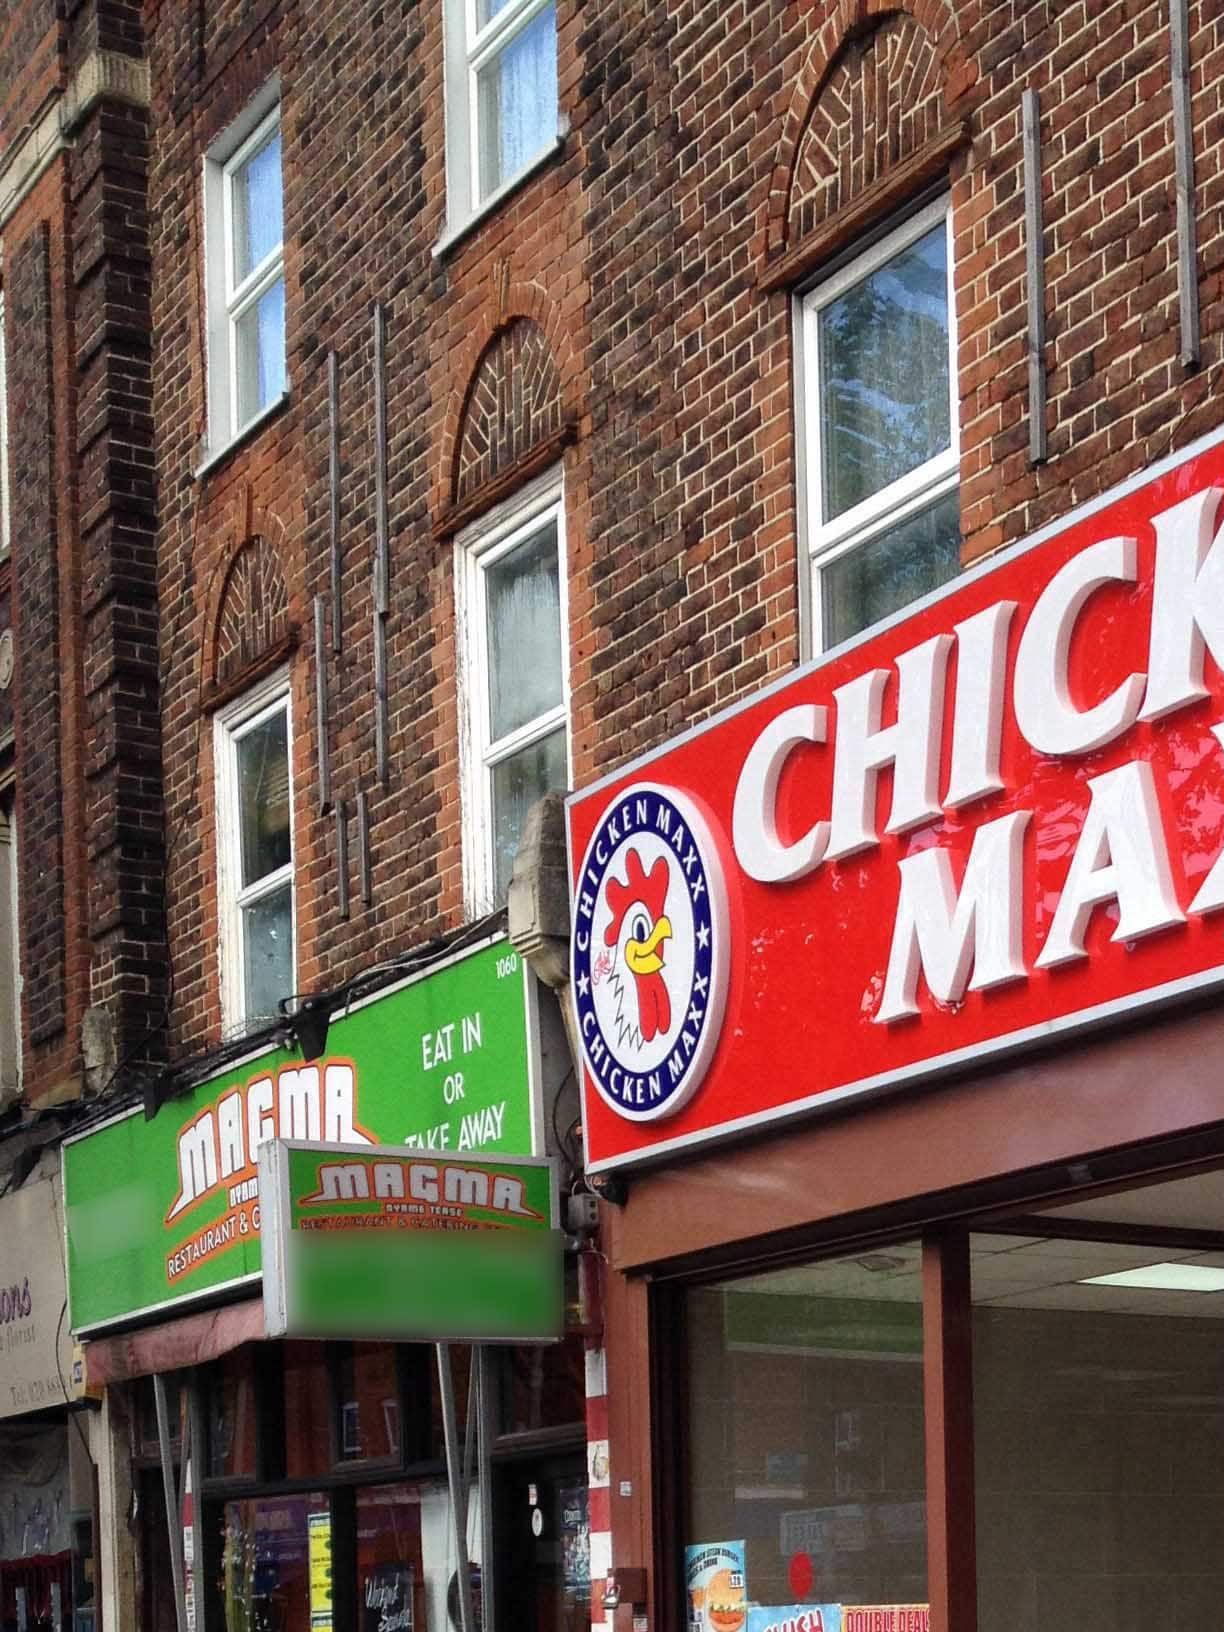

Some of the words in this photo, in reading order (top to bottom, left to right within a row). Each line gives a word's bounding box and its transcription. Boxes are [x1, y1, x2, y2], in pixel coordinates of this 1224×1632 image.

[576, 799, 648, 953] CHICKEN
[655, 803, 706, 904] MAXX
[496, 954, 517, 979] 1060
[421, 1023, 455, 1071] EAT
[461, 1012, 482, 1053] IN
[582, 1012, 663, 1104] CHICKEN
[667, 972, 709, 1078] MAXX
[443, 1072, 465, 1105] OR
[165, 1064, 376, 1223] MAGMA
[458, 1101, 505, 1152] AWAY
[301, 1162, 540, 1218] MAGMA
[167, 1215, 237, 1279] RESTAURANT
[239, 1211, 249, 1235] &
